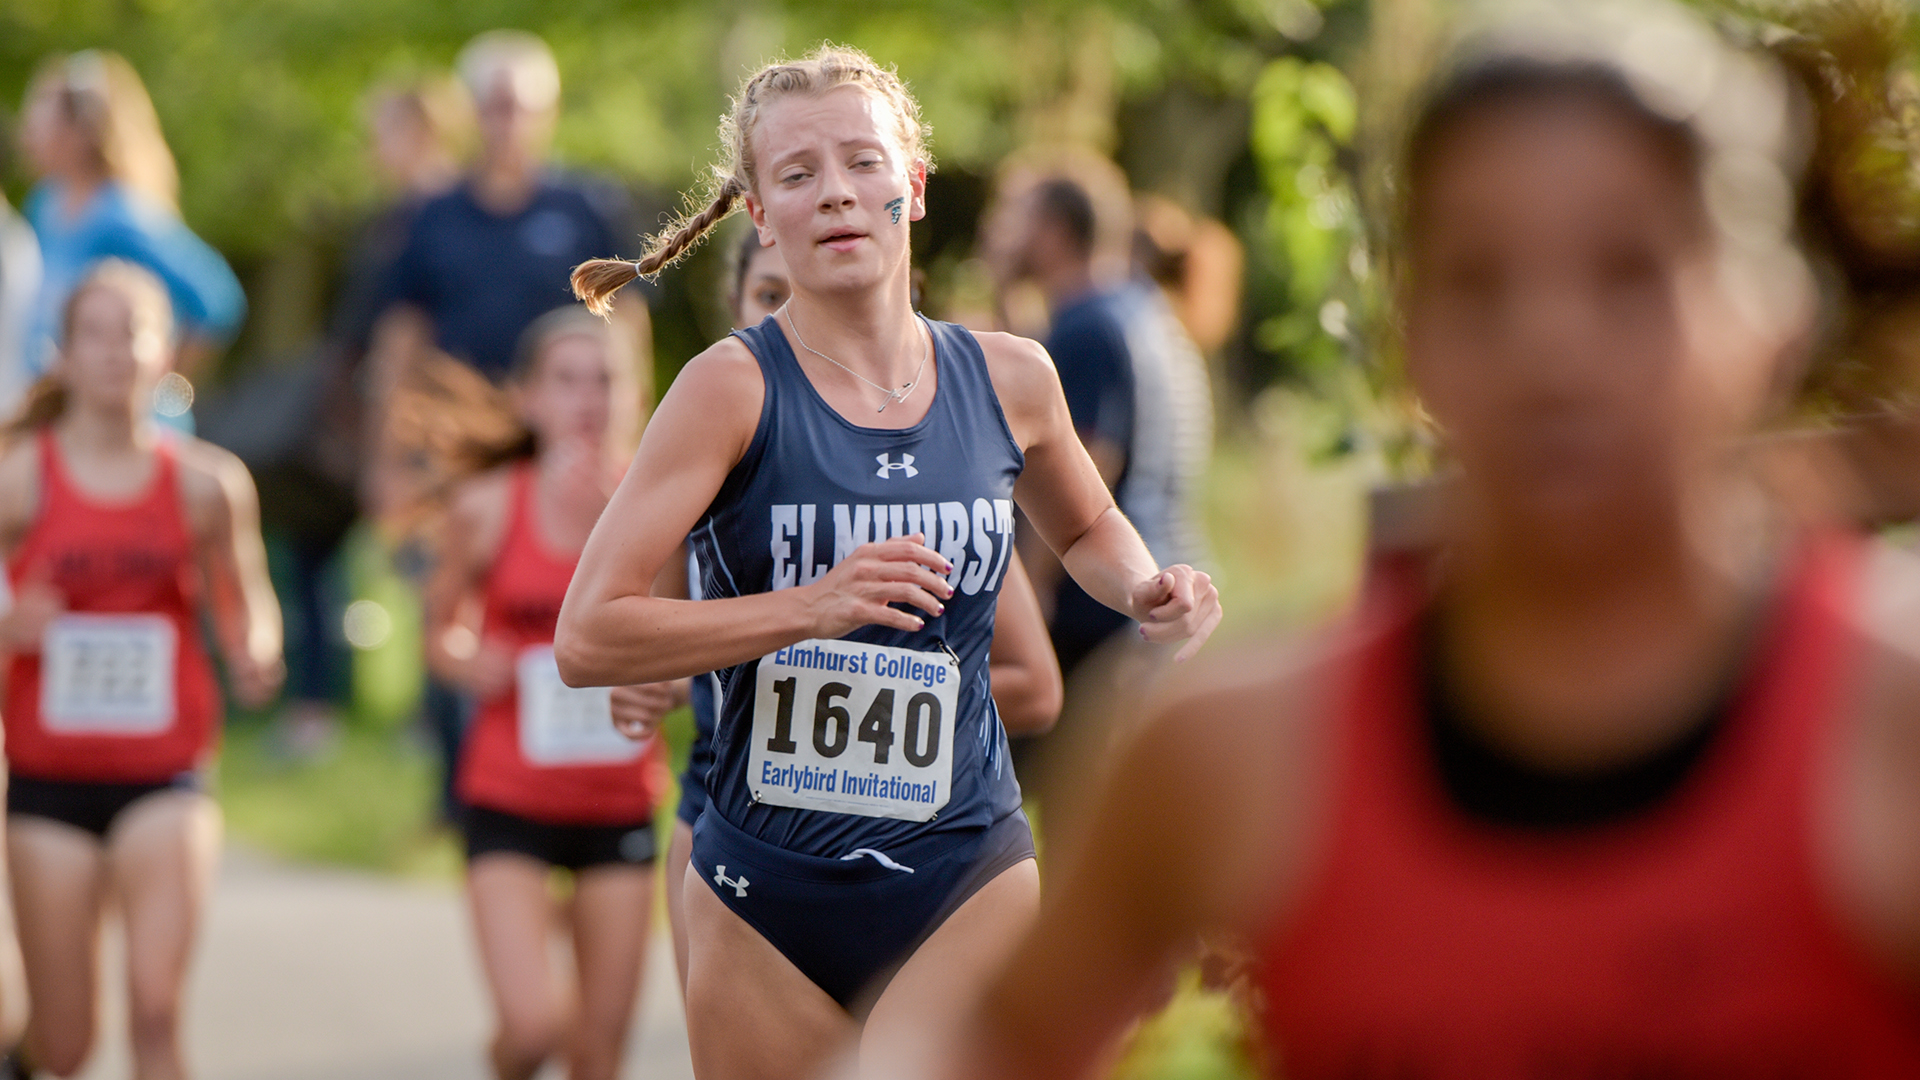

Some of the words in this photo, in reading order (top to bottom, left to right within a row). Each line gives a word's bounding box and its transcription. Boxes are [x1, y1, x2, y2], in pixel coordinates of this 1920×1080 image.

[774, 645, 868, 674] Elmhurst
[874, 652, 947, 688] College
[766, 676, 942, 768] 1640
[761, 760, 838, 794] Earlybird
[841, 769, 937, 804] Invitational
